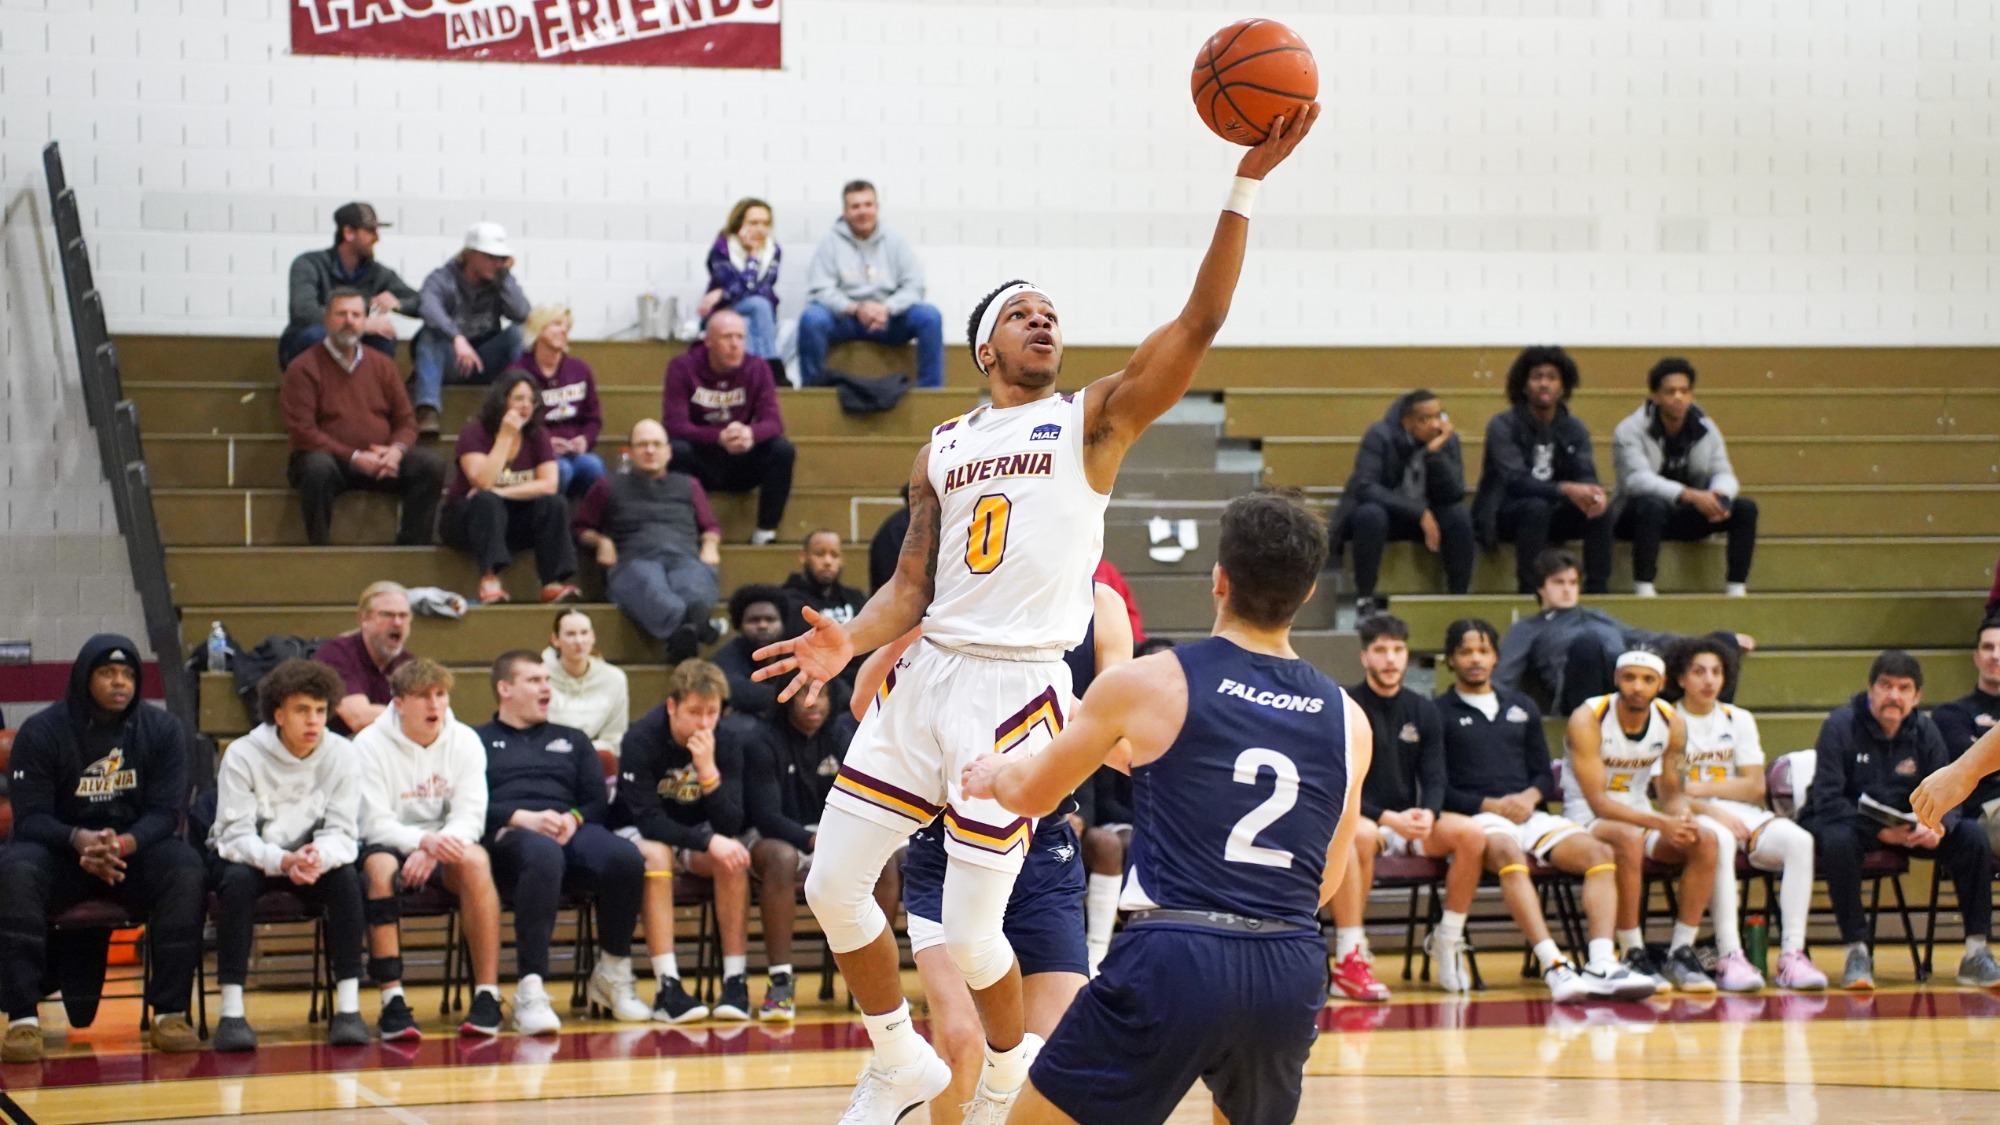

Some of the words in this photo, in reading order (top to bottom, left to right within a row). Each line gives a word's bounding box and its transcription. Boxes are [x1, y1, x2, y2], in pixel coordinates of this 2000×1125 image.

[451, 5, 518, 45] AND
[532, 0, 776, 54] FRIEN
[1032, 431, 1059, 440] MAC
[944, 452, 1053, 495] ALVERNIA
[965, 492, 1012, 575] 0
[1216, 678, 1325, 714] FALCONS
[79, 771, 135, 793] ALVENIA
[1608, 773, 1633, 792] 5
[1224, 747, 1301, 869] 2
